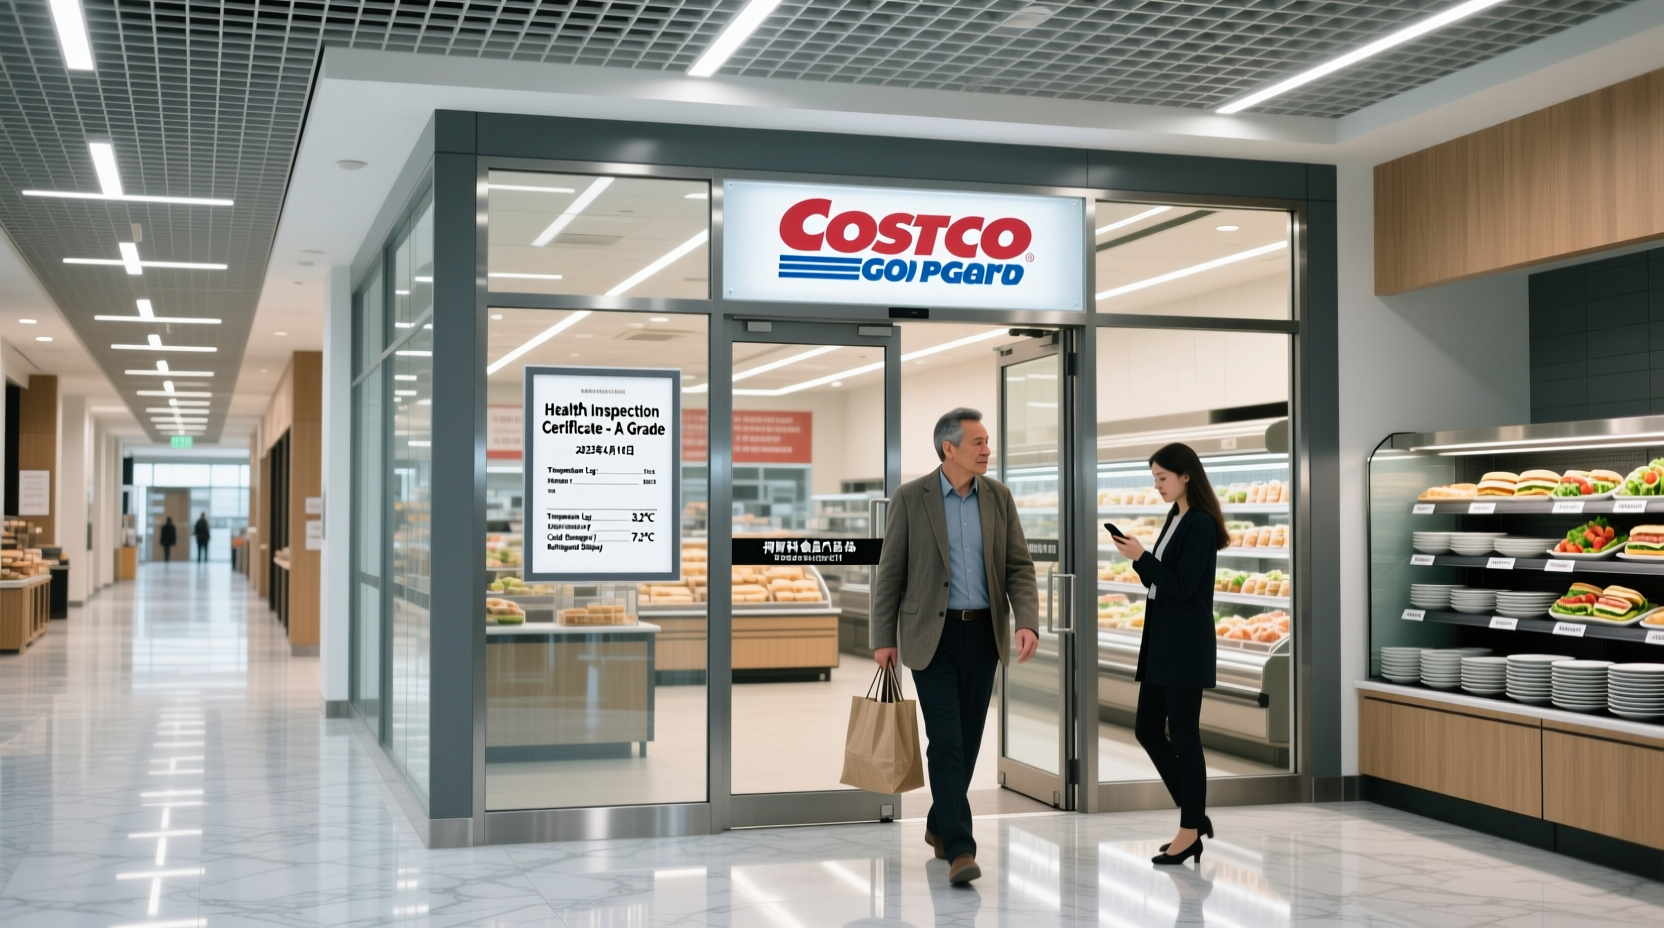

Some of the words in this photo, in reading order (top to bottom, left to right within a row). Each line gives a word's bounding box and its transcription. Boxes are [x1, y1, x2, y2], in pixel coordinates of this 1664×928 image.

[779, 198, 1032, 260] COSTCO
[545, 401, 588, 417] Health
[591, 403, 660, 421] Inspection
[614, 421, 625, 436] A
[627, 421, 666, 436] Grade
